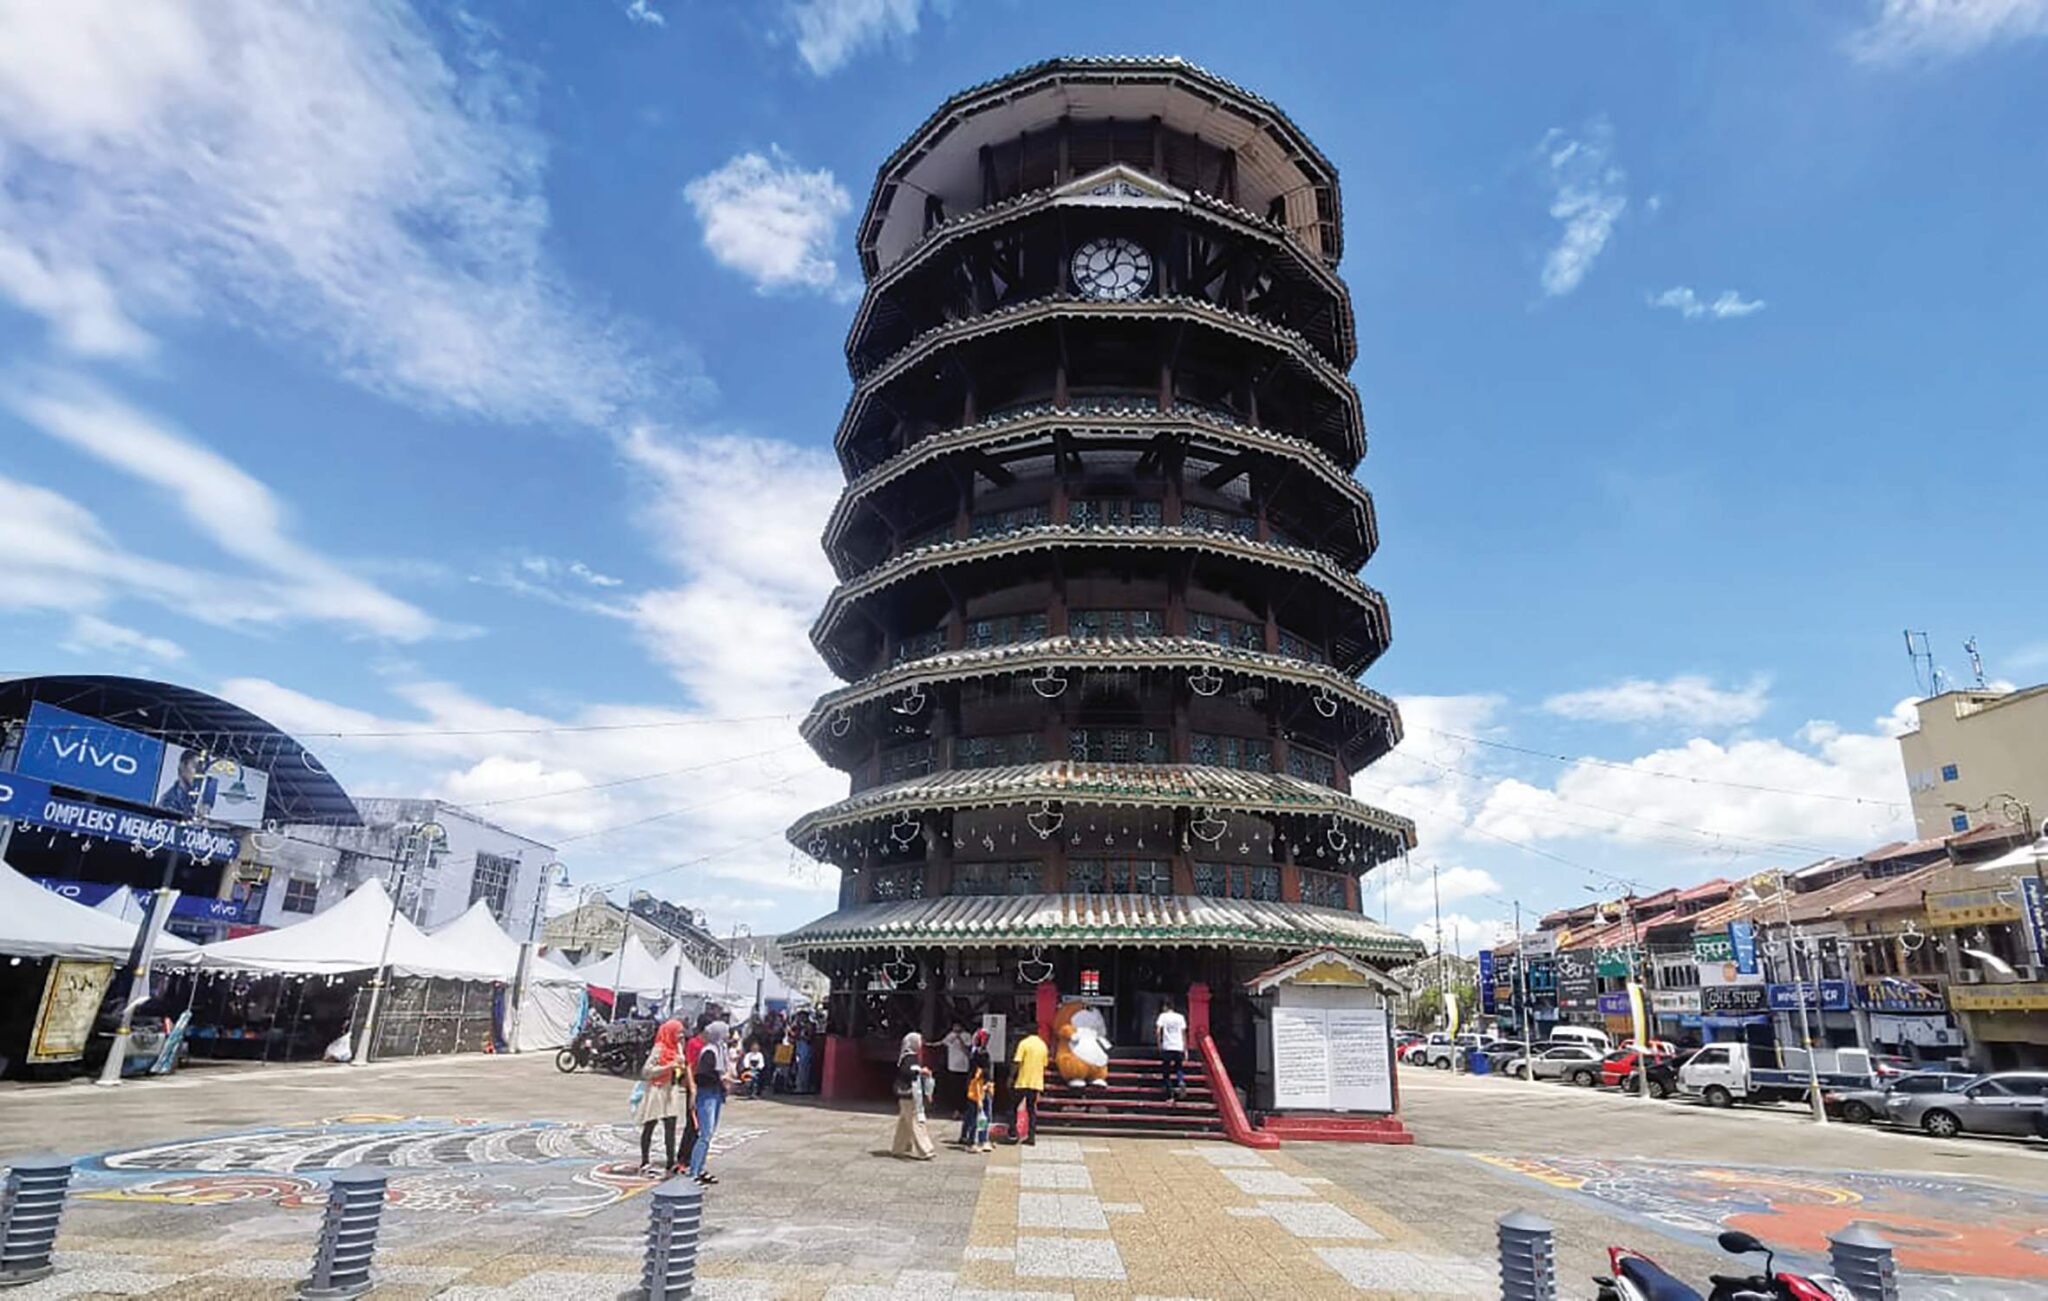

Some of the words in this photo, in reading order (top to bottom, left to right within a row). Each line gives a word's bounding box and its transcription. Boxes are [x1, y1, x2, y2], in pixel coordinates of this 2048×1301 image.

[52, 735, 137, 775] vivo
[43, 801, 116, 832] OMPLEKS
[210, 900, 237, 915] vivo
[1732, 990, 1761, 1004] STOP
